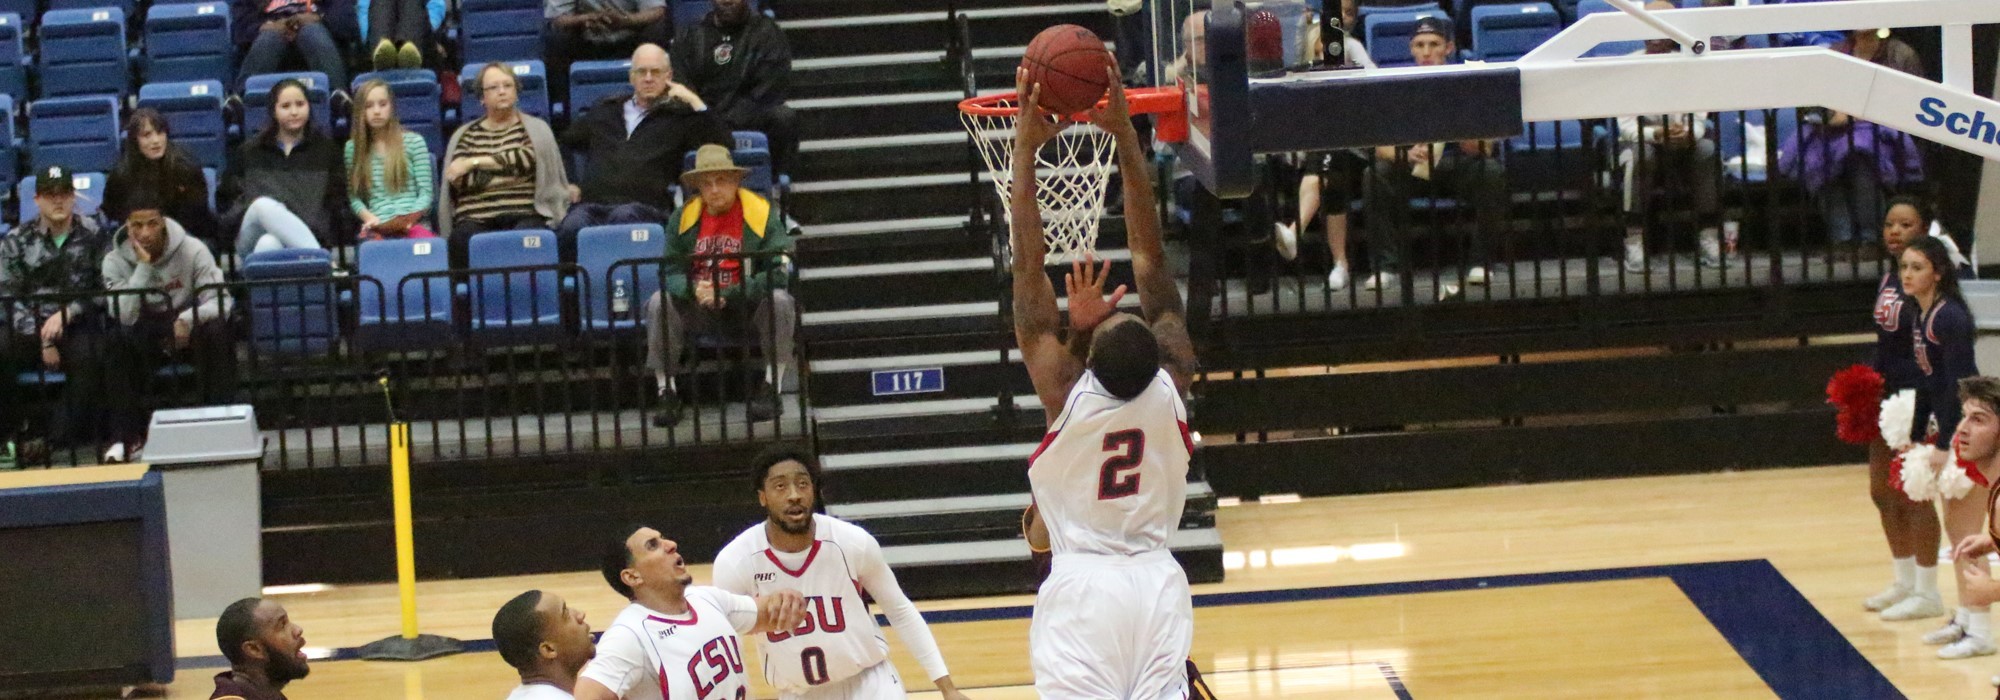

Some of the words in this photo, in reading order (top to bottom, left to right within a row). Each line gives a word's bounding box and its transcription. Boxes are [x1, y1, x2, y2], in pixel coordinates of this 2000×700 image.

[1915, 97, 2000, 146] Sch
[893, 372, 923, 391] 117
[1098, 428, 1146, 500] 2
[687, 635, 744, 700] CSU
[801, 646, 830, 685] 0
